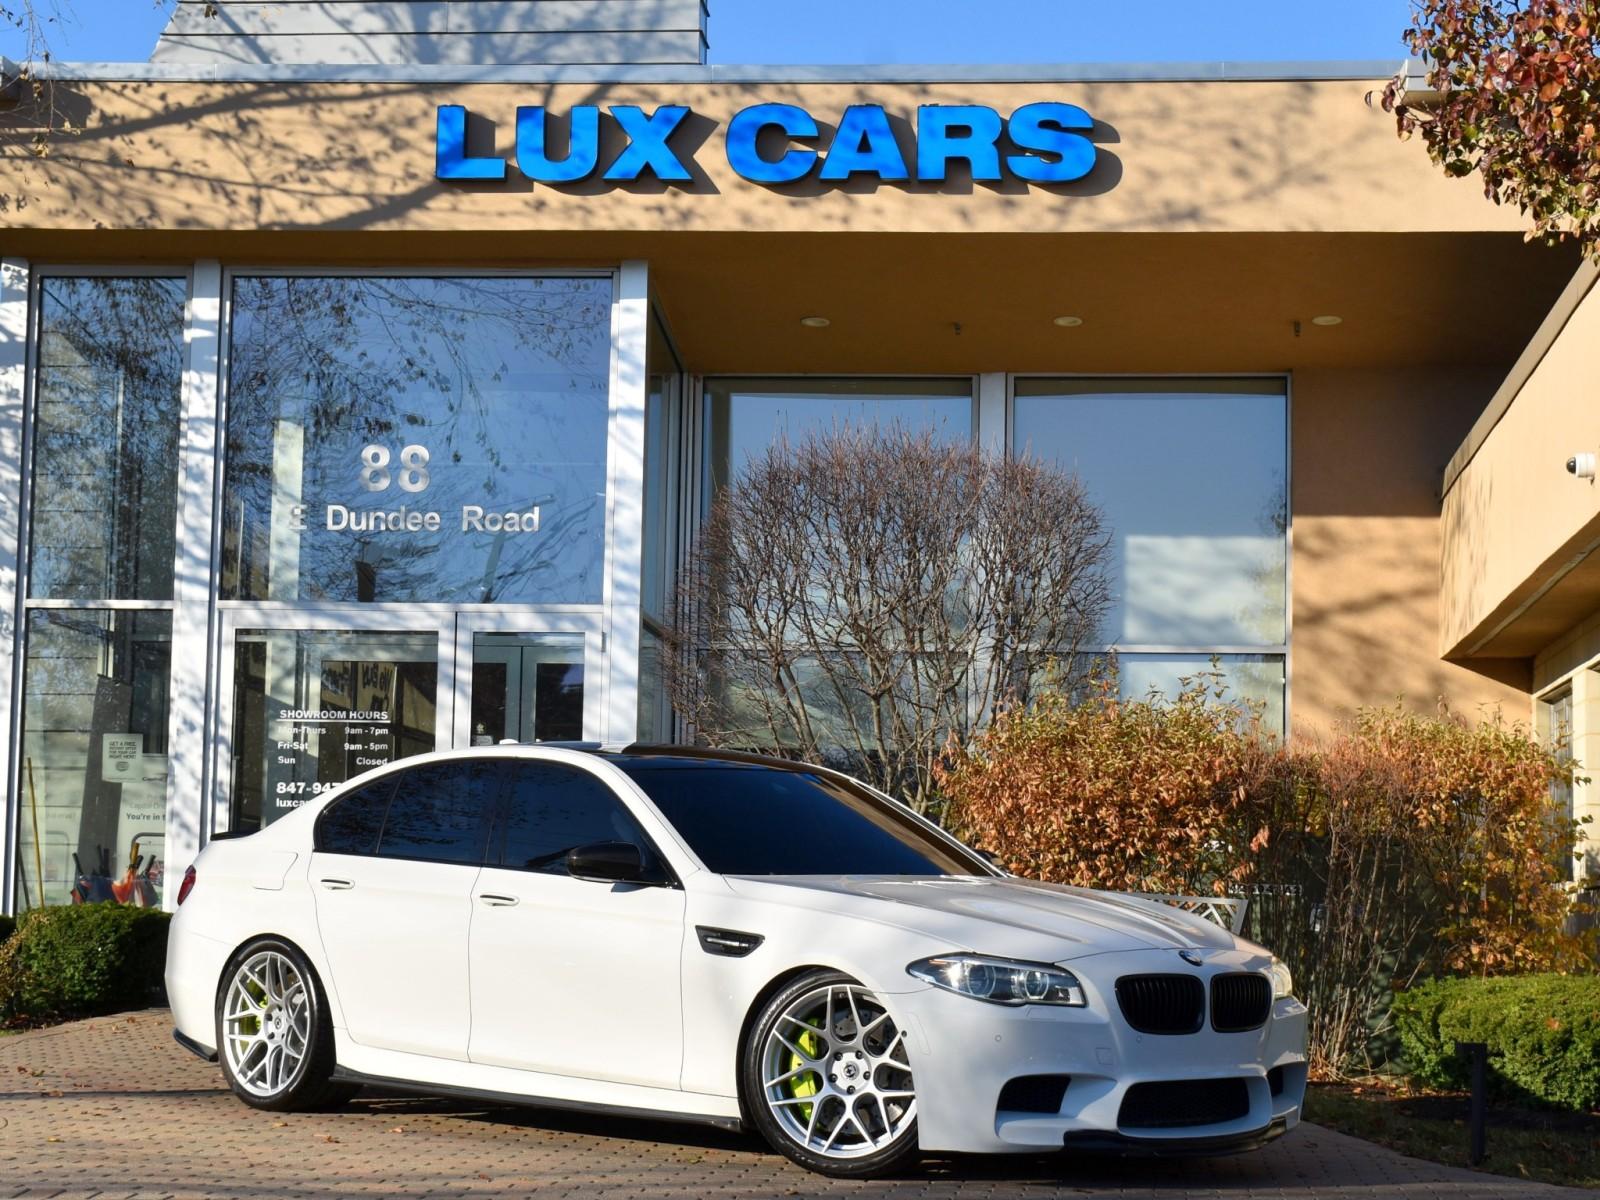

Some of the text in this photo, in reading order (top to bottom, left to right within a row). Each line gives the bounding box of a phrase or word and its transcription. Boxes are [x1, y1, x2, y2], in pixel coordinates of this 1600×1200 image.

[436, 101, 1097, 184] LUX CARS
[360, 444, 430, 493] 88
[326, 504, 441, 532] Dundee
[462, 505, 540, 532] Road
[279, 709, 389, 720] SHOWROOM HOURS
[344, 726, 363, 735] 9am
[369, 726, 389, 736] 7pm
[277, 741, 309, 750] Fri-Sat
[343, 742, 363, 751] 9am
[369, 742, 389, 752] 5pm
[277, 755, 389, 767] Sun Closed
[126, 812, 151, 820] You're
